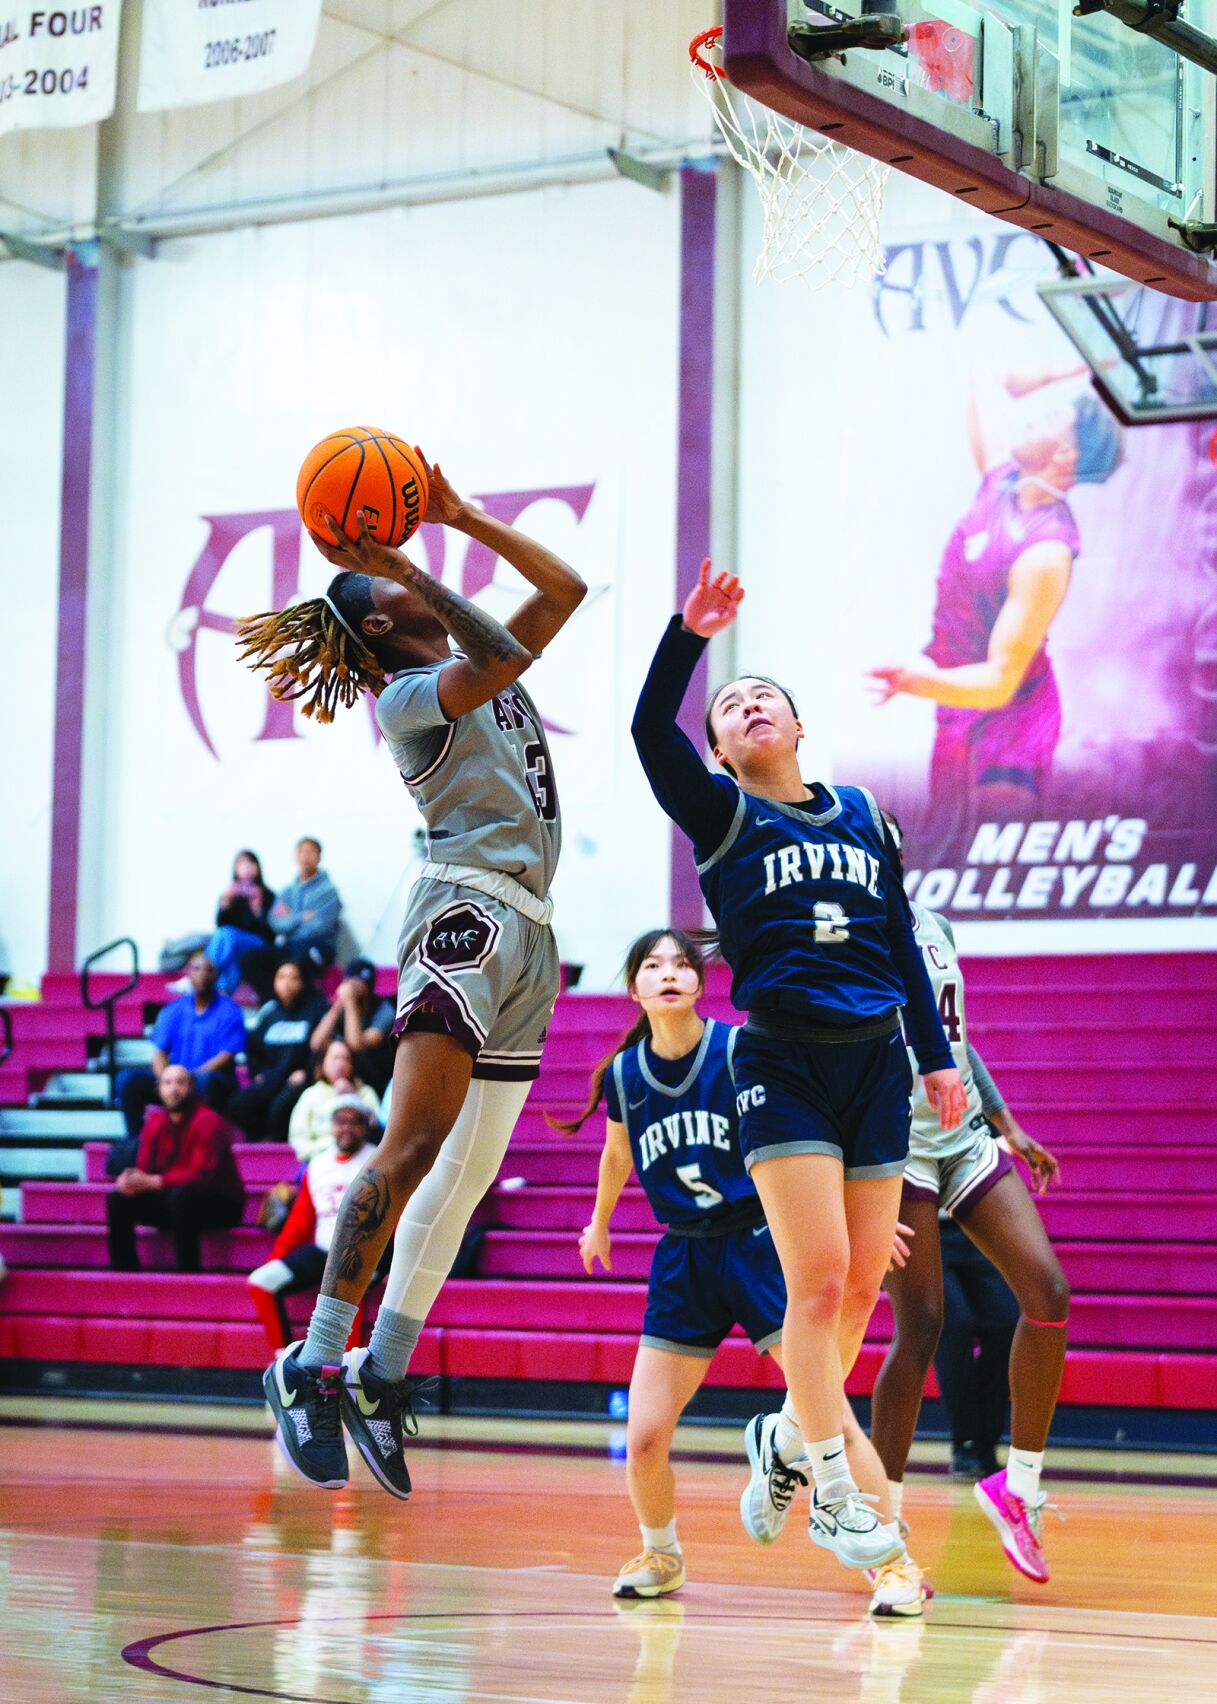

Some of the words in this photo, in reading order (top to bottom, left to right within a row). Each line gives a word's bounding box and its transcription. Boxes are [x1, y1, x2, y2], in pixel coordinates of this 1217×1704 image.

[30, 5, 103, 37] FOUR
[966, 814, 1148, 865] MEN'S
[763, 841, 883, 900] IRVINE
[813, 901, 850, 944] 2
[639, 1110, 731, 1171] IRVINE
[675, 1162, 724, 1209] 5
